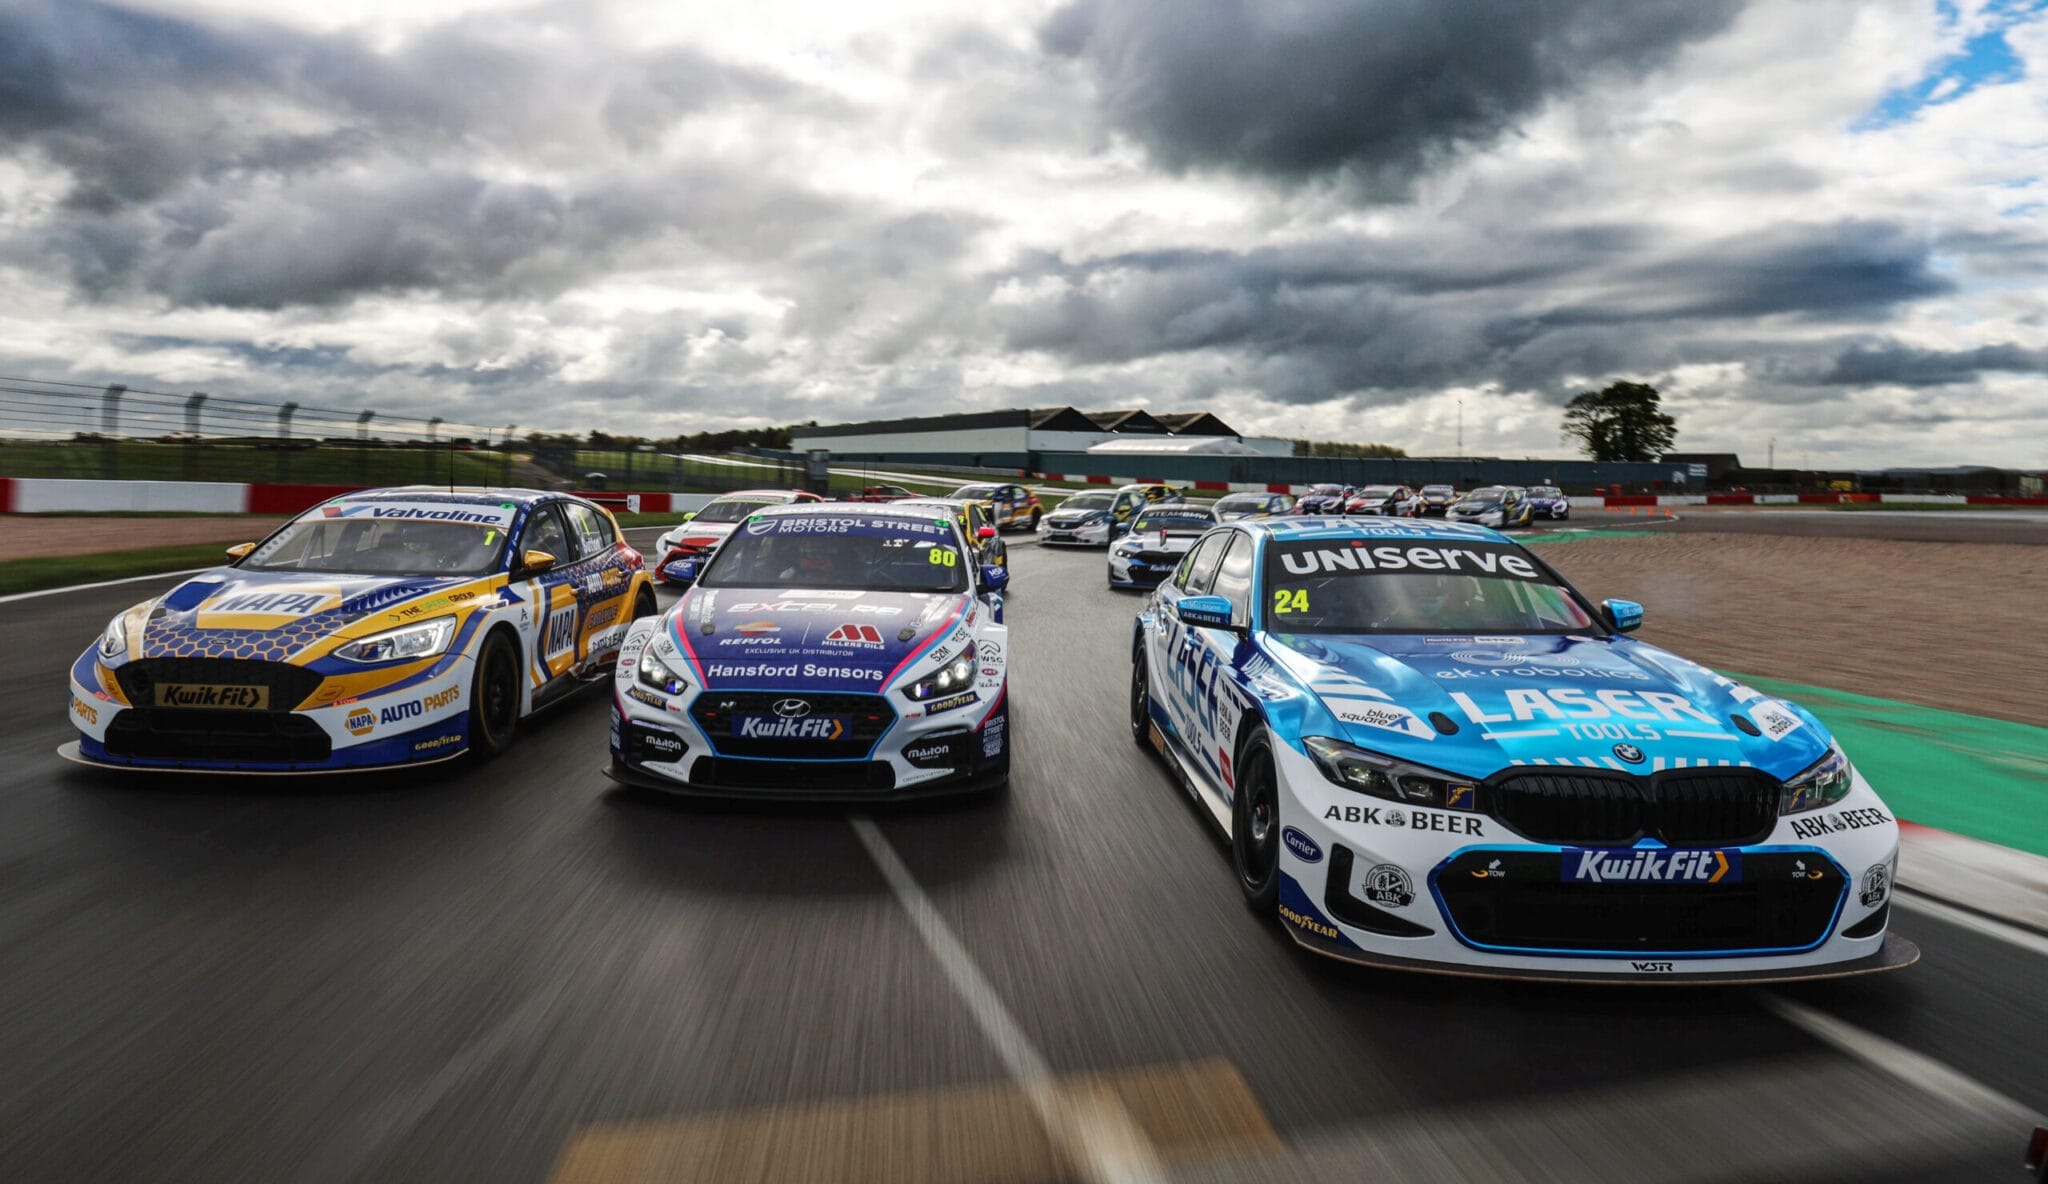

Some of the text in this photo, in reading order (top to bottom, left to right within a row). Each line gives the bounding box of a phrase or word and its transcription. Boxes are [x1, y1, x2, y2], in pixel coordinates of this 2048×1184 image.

[373, 507, 502, 525] Valvoline
[1148, 511, 1208, 520] #TEAMBMW
[778, 524, 849, 535] MOTORS
[782, 517, 951, 536] BRISTOL STREET
[1353, 527, 1427, 537] TOOLS
[484, 531, 496, 546] 1
[929, 548, 956, 567] 80
[212, 593, 326, 614] NAPA
[399, 604, 421, 618] THE
[448, 591, 476, 603] GROUP
[1273, 589, 1309, 613] 24
[548, 609, 575, 656] NAPA
[720, 637, 783, 646] REPSOL
[803, 648, 855, 657] DISTRIBUTOR
[865, 643, 886, 651] OILS
[981, 655, 1003, 664] WSC
[708, 664, 884, 681] Hansford Sensors
[74, 696, 98, 726] PARTS
[349, 714, 374, 730] NAPA
[380, 700, 422, 725] AUTO
[423, 685, 460, 713] PARTS
[931, 694, 975, 712] GOODYEAR
[1448, 688, 1723, 727] LASER
[1339, 710, 1390, 728] square
[1367, 707, 1397, 721] blue
[1560, 723, 1664, 741] TOOLS
[414, 734, 462, 751] GOODYEAR
[1324, 805, 1484, 837] ABK BEER
[1790, 808, 1893, 840] ABK BEER
[1285, 831, 1317, 857] Carrier
[1488, 869, 1506, 878] TOW
[1792, 872, 1807, 880] TOW
[1376, 890, 1402, 904] ABK
[1279, 904, 1338, 940] GOODYEAR
[1631, 962, 1673, 972] WSR
